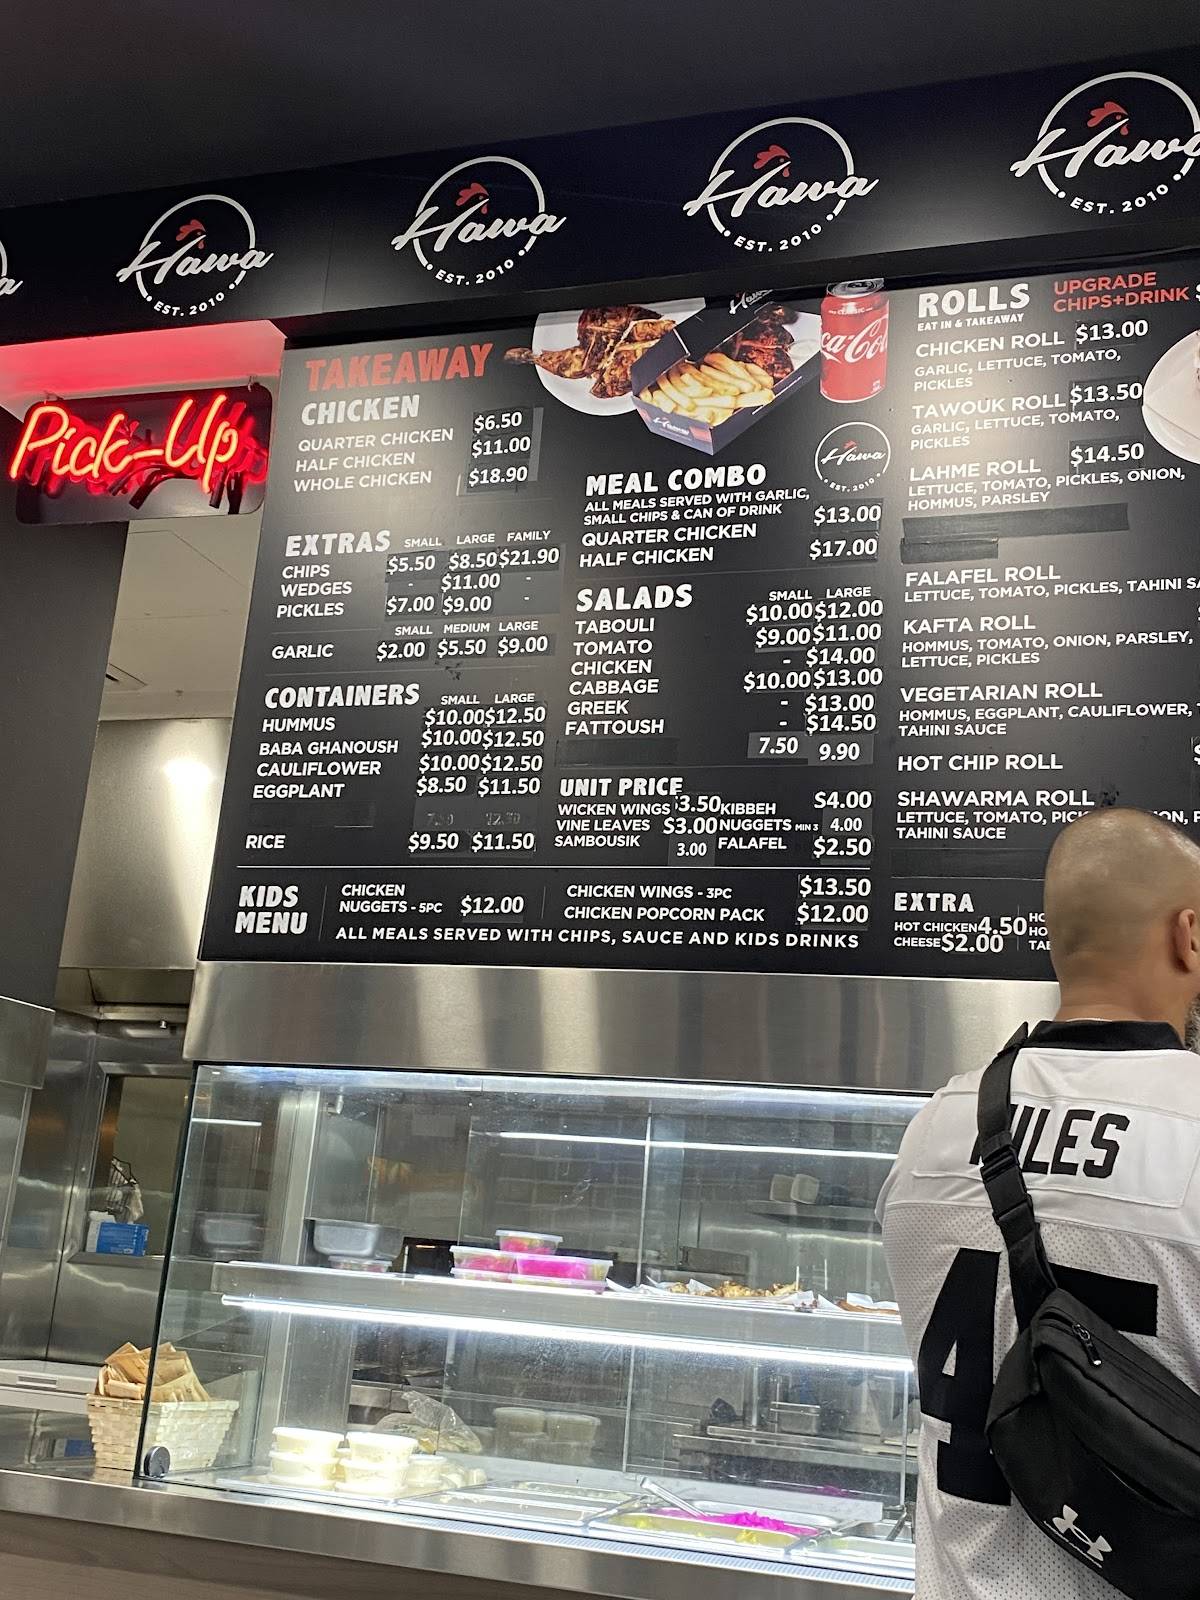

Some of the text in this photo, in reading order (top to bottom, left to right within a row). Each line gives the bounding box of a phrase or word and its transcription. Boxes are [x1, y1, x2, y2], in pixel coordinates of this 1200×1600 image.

[683, 161, 879, 218] Hawa
[1070, 184, 1169, 214] EST. 2010
[391, 198, 567, 253] Hawa
[734, 223, 822, 253] EST. 2010
[115, 234, 274, 285] Hawa
[435, 258, 515, 286] EST. 2010
[1054, 272, 1156, 295] UPGRADE
[153, 291, 225, 317] EST. 2010
[918, 283, 1030, 318] ROLLS
[1053, 287, 1189, 313] CHIPS+DRINK
[918, 313, 1024, 331] EAT IN & TAKEAWAY
[1076, 320, 1149, 345] $13.00
[915, 331, 1065, 358] CHICKEN ROLL
[306, 342, 494, 392] TAKEAWAY
[914, 349, 1122, 377] GARLIC, LETTUCE, TOMATO,
[914, 377, 973, 392] PICKLES
[1070, 382, 1143, 408] $13.50
[301, 394, 420, 426] CHICKEN
[912, 393, 1066, 419] TAWOUK ROLL
[474, 412, 522, 434] $6.50
[9, 394, 238, 495] Pick-Up
[298, 428, 454, 452] QUARTER CHICKEN
[821, 447, 886, 465] Hawa
[1070, 443, 1144, 468] $14.50
[585, 463, 767, 496] MEAL COMBO
[910, 459, 1041, 482] LAHME ROLL
[853, 478, 874, 491] 2010
[585, 488, 810, 513] ALL MEALS SERVED WITH GARLIC,
[584, 503, 783, 526] SMALL CHIPS & CAN OF DRINK
[813, 504, 882, 527] $13.00
[285, 530, 391, 557] EXTRAS
[404, 531, 551, 548] SMALL LARGE FAMILY
[809, 538, 878, 560] $17.00
[387, 548, 560, 574] $5.50 $8.50 $21.90
[282, 564, 330, 579] CHIPS
[906, 565, 1061, 587] FALAFEL ROLL
[280, 581, 353, 597] WEDGES
[576, 584, 693, 613] SALADS
[904, 589, 975, 603] LETTUCE,
[979, 585, 1050, 600] TOMATO,
[1054, 581, 1123, 596] PICKLES,
[1127, 578, 1182, 592] TAHINI
[277, 602, 344, 618] PICKLES
[746, 599, 884, 625] $10.00 $12.00
[395, 621, 539, 636] SMALL MEDIUM LARGE
[575, 618, 655, 635] TABOULI
[904, 615, 1036, 635] KAFTA ROLL
[272, 644, 335, 660] GARLIC
[574, 639, 653, 656] TOMATO
[570, 659, 653, 676] CHICKEN
[265, 683, 420, 709] CONTAINERS
[569, 678, 659, 696] CABBAGE
[900, 682, 1103, 702] VEGETARIAN ROLL
[424, 706, 547, 728] $10.00 $12.50
[568, 700, 629, 715] GREEK
[900, 702, 1192, 722] HOMMUS, EGGPLANT, CAULIFLOWER,
[262, 717, 336, 733] HUMMUS
[565, 719, 665, 736] FATTOUSH
[900, 724, 1007, 737] TAHINI SAUCE
[259, 740, 399, 756] BABA GHANOUSH
[759, 737, 860, 761] 7.50 9.90
[257, 761, 382, 777] CAULIFLOWER
[898, 754, 1064, 772] HOT CHIP ROLL
[253, 783, 345, 799] EGGPLANT
[560, 777, 683, 796] UNIT PRICE
[814, 791, 872, 809] $4.00
[898, 790, 1095, 807] SHAWARMA ROLL
[621, 803, 671, 815] WINGS
[721, 803, 776, 815] KIBBEH
[556, 819, 650, 831] VINE LEAVES
[663, 817, 718, 834] $3.00
[719, 819, 792, 832] NUGGETS
[245, 834, 286, 849] RICE
[408, 832, 535, 852] $9.50 $11.50
[554, 835, 641, 847] SAMBOUSIK
[718, 837, 787, 850] FALAFEL
[341, 884, 406, 897] CHICKEN
[566, 885, 732, 899] CHICKEN WINGS 3PC
[799, 875, 872, 898] $13.50
[238, 886, 300, 908] KIDS
[339, 901, 442, 913] NUGGETS 5PC
[460, 895, 524, 917] $12.00
[894, 892, 974, 912] EXTRA
[235, 912, 308, 934] MENU
[894, 922, 978, 932] HOT CHICKEN
[978, 916, 1028, 935] 4.50
[336, 927, 859, 948] ALL MEALS SERVED WITH CHIPS, SAUCE AND KIDS DRINKS
[894, 937, 941, 947] CHEESE
[941, 933, 1004, 953] $2.00
[969, 1104, 1130, 1178] ILES
